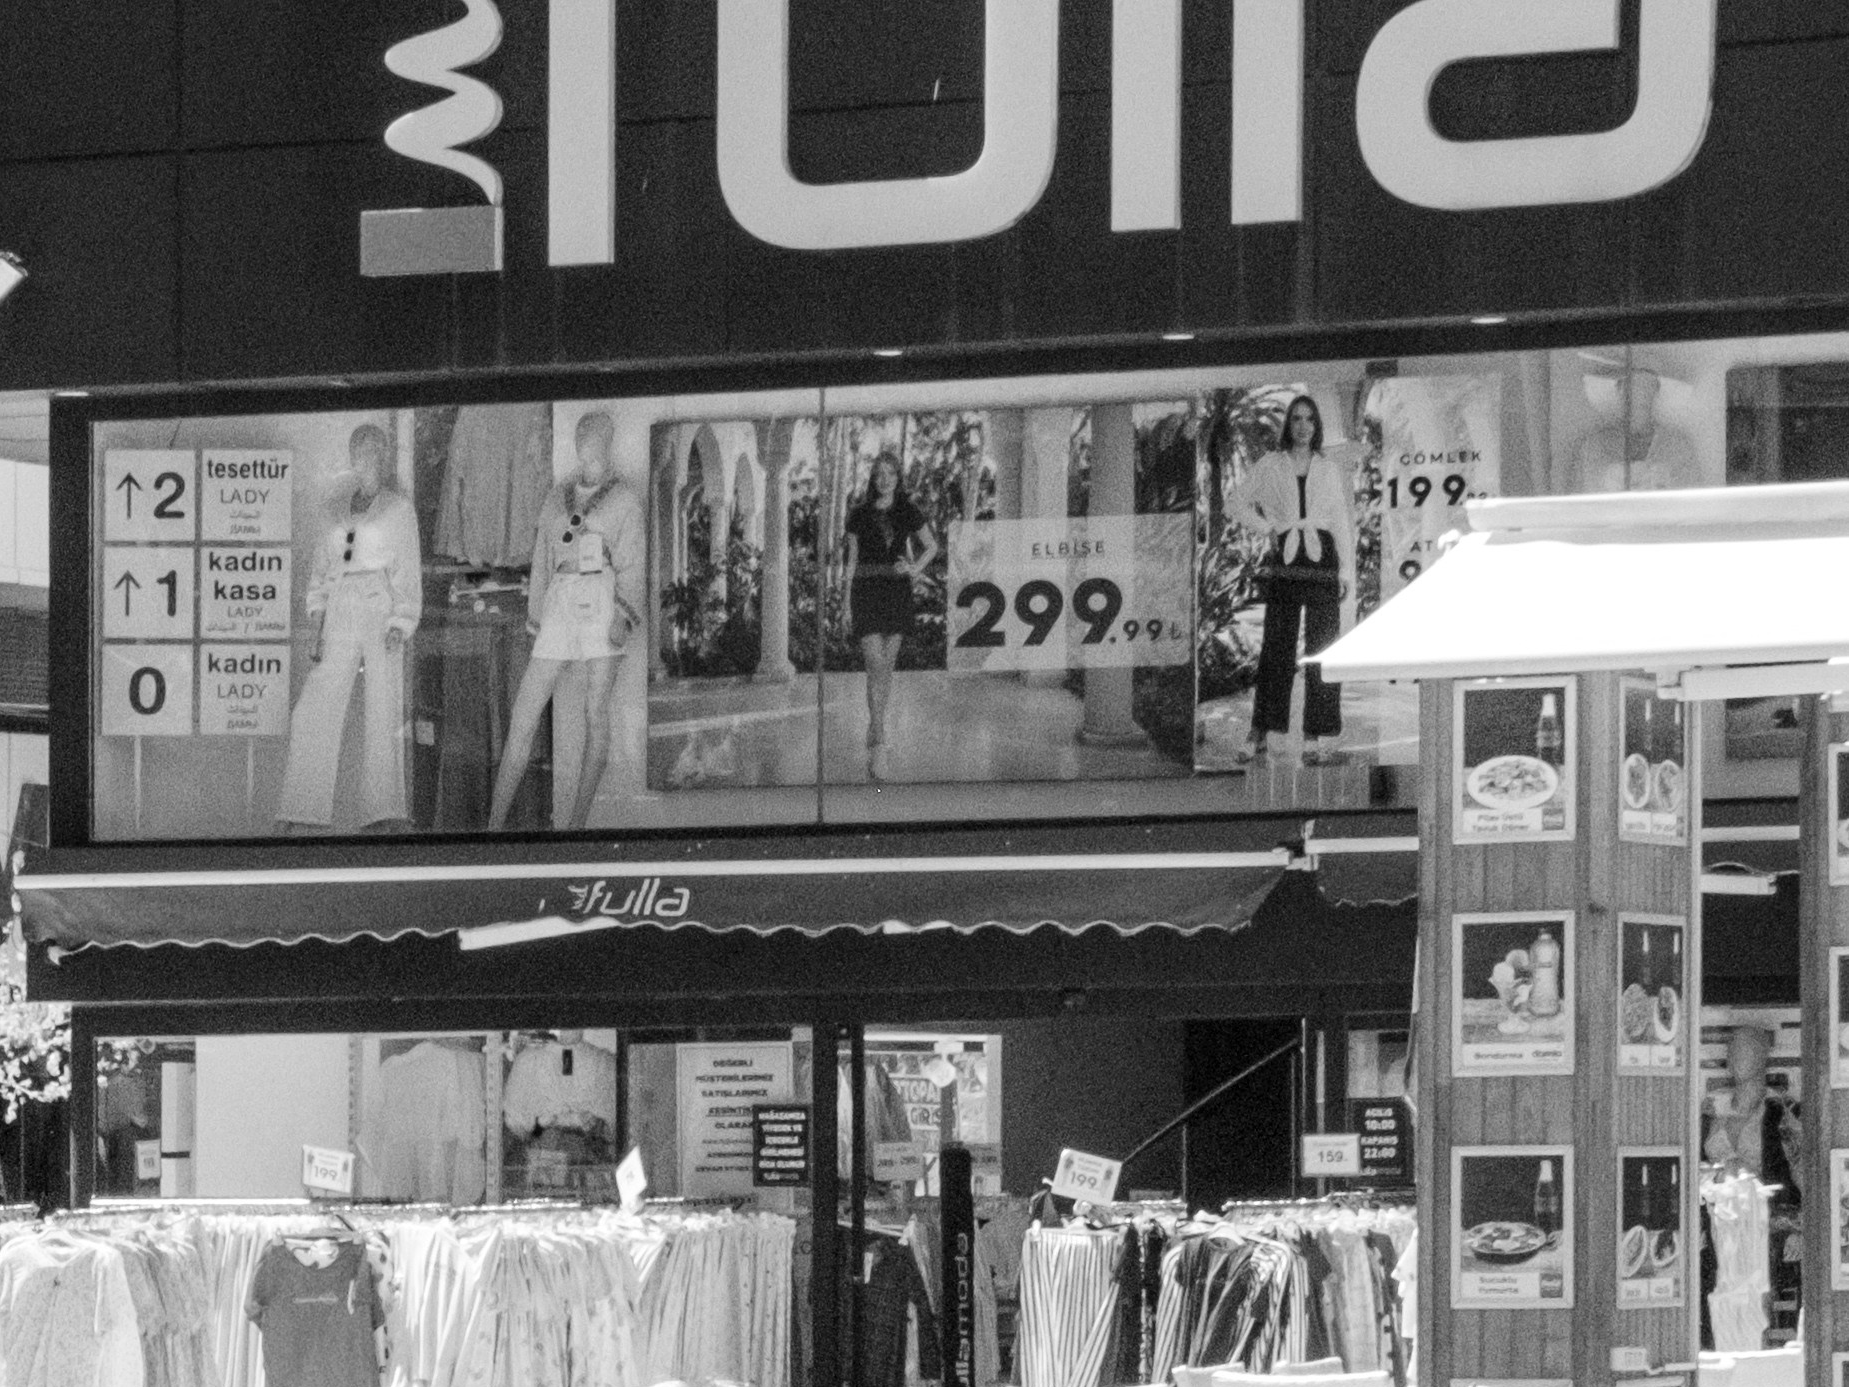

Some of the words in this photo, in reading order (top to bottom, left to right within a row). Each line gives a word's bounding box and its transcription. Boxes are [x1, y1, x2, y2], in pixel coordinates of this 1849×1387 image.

[207, 458, 290, 480] tesettür
[153, 471, 186, 519] 2
[220, 488, 271, 505] LADY
[209, 551, 283, 573] kadın
[156, 570, 177, 617] 1
[214, 580, 277, 601] kasa
[227, 606, 264, 618] LADY
[208, 653, 282, 675] kadın
[128, 666, 166, 715] 0
[217, 683, 268, 700] LADY
[582, 878, 691, 917] fulla
